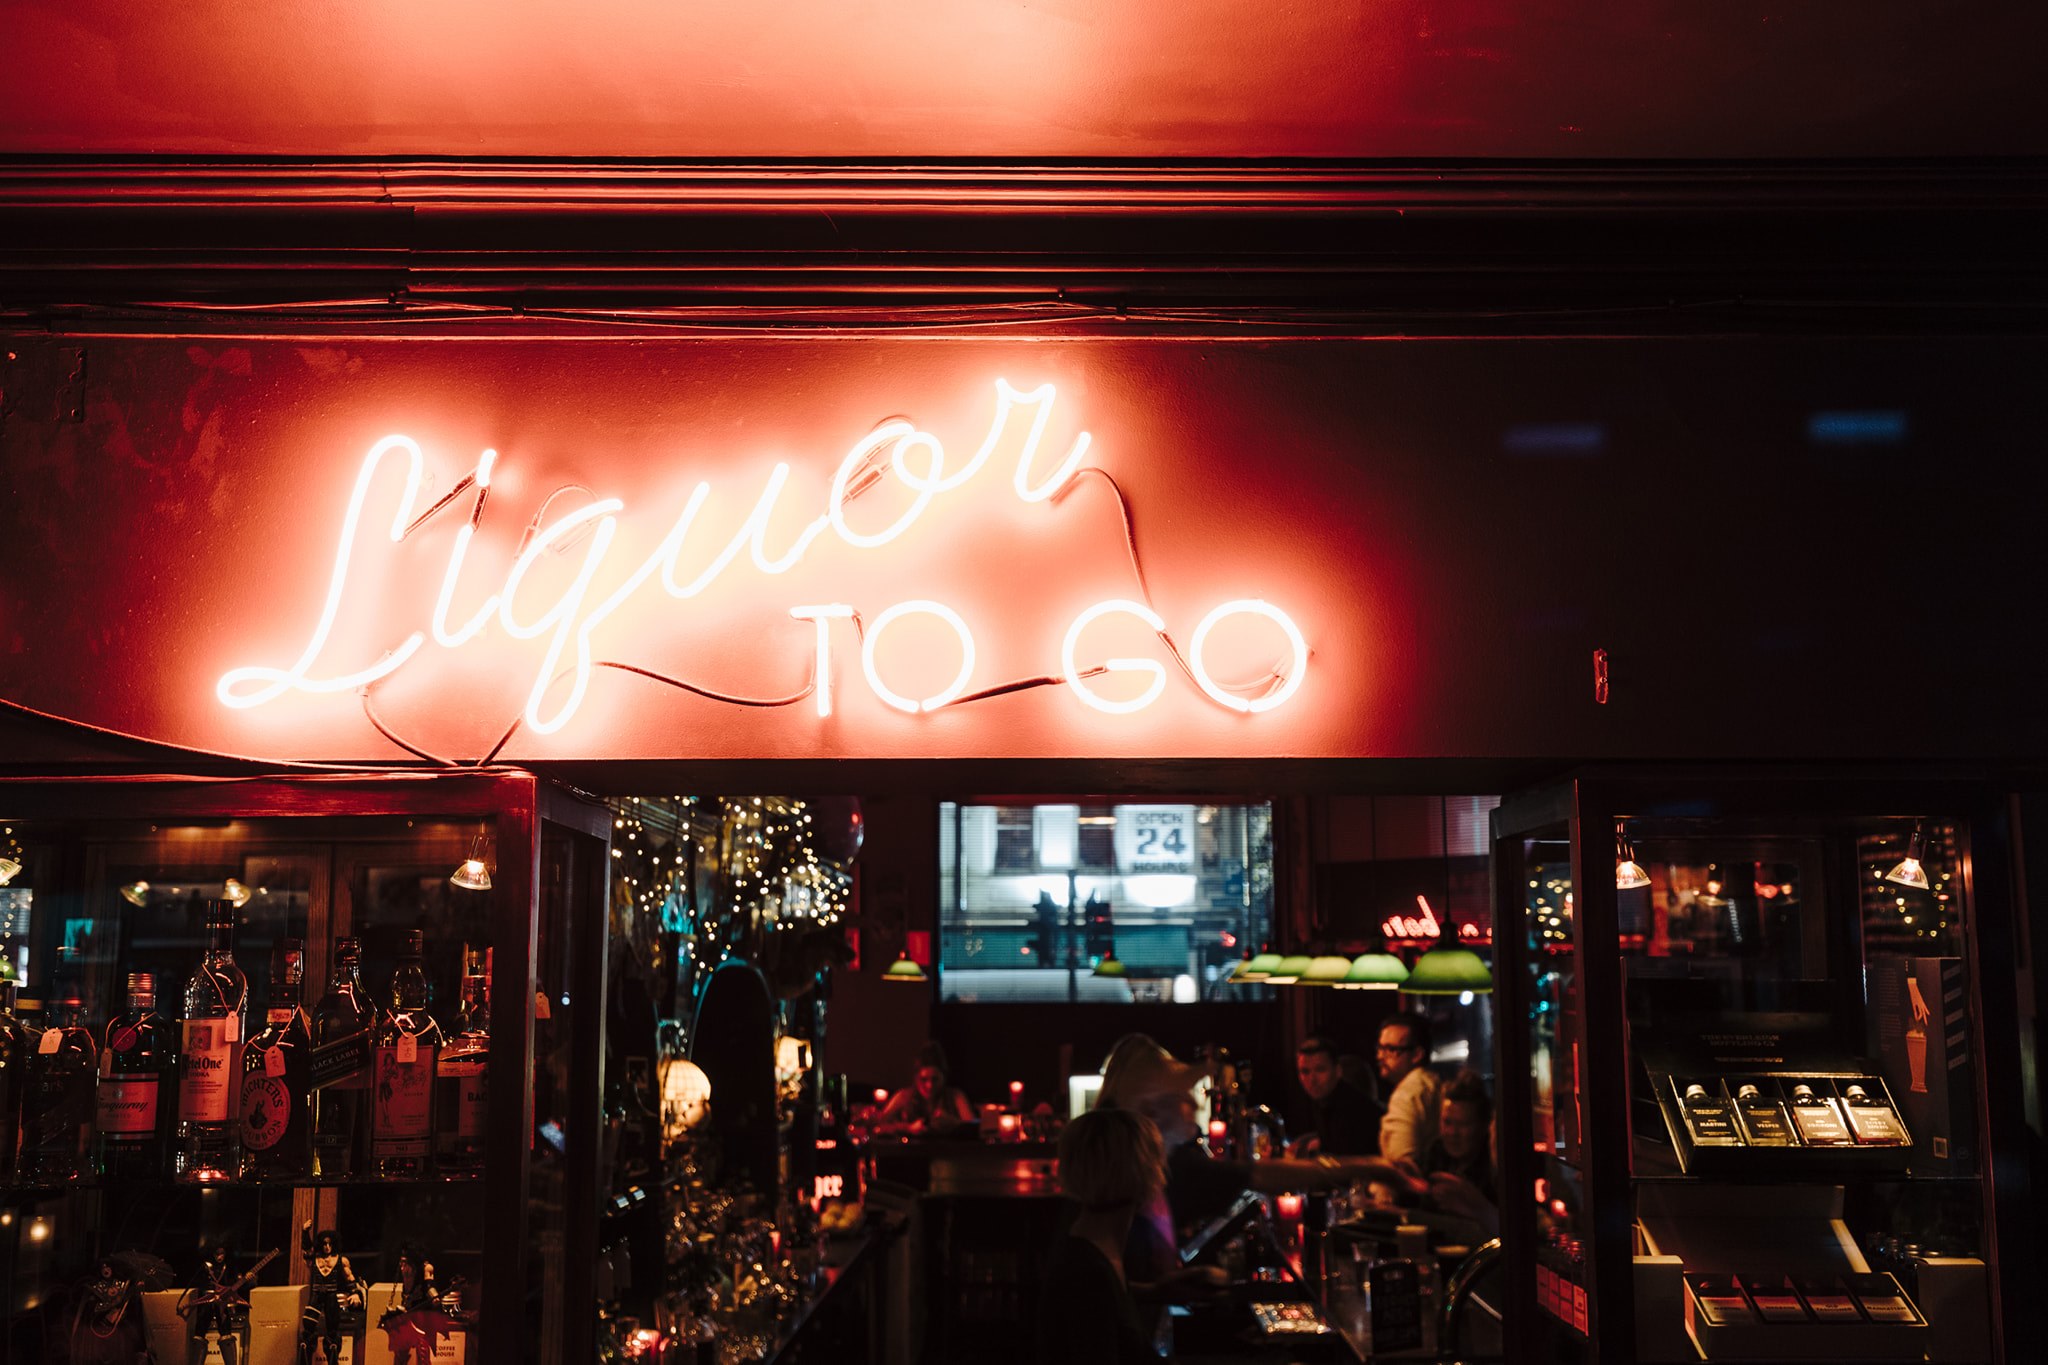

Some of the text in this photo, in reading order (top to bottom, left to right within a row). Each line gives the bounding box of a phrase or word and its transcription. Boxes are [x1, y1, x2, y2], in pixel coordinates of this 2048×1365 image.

[216, 377, 1092, 735] Liquor
[790, 599, 1310, 719] TO GO
[1135, 813, 1183, 824] OPEN
[1136, 828, 1187, 855] 24
[1133, 862, 1188, 873] HOURS
[335, 1047, 361, 1063] LABEL
